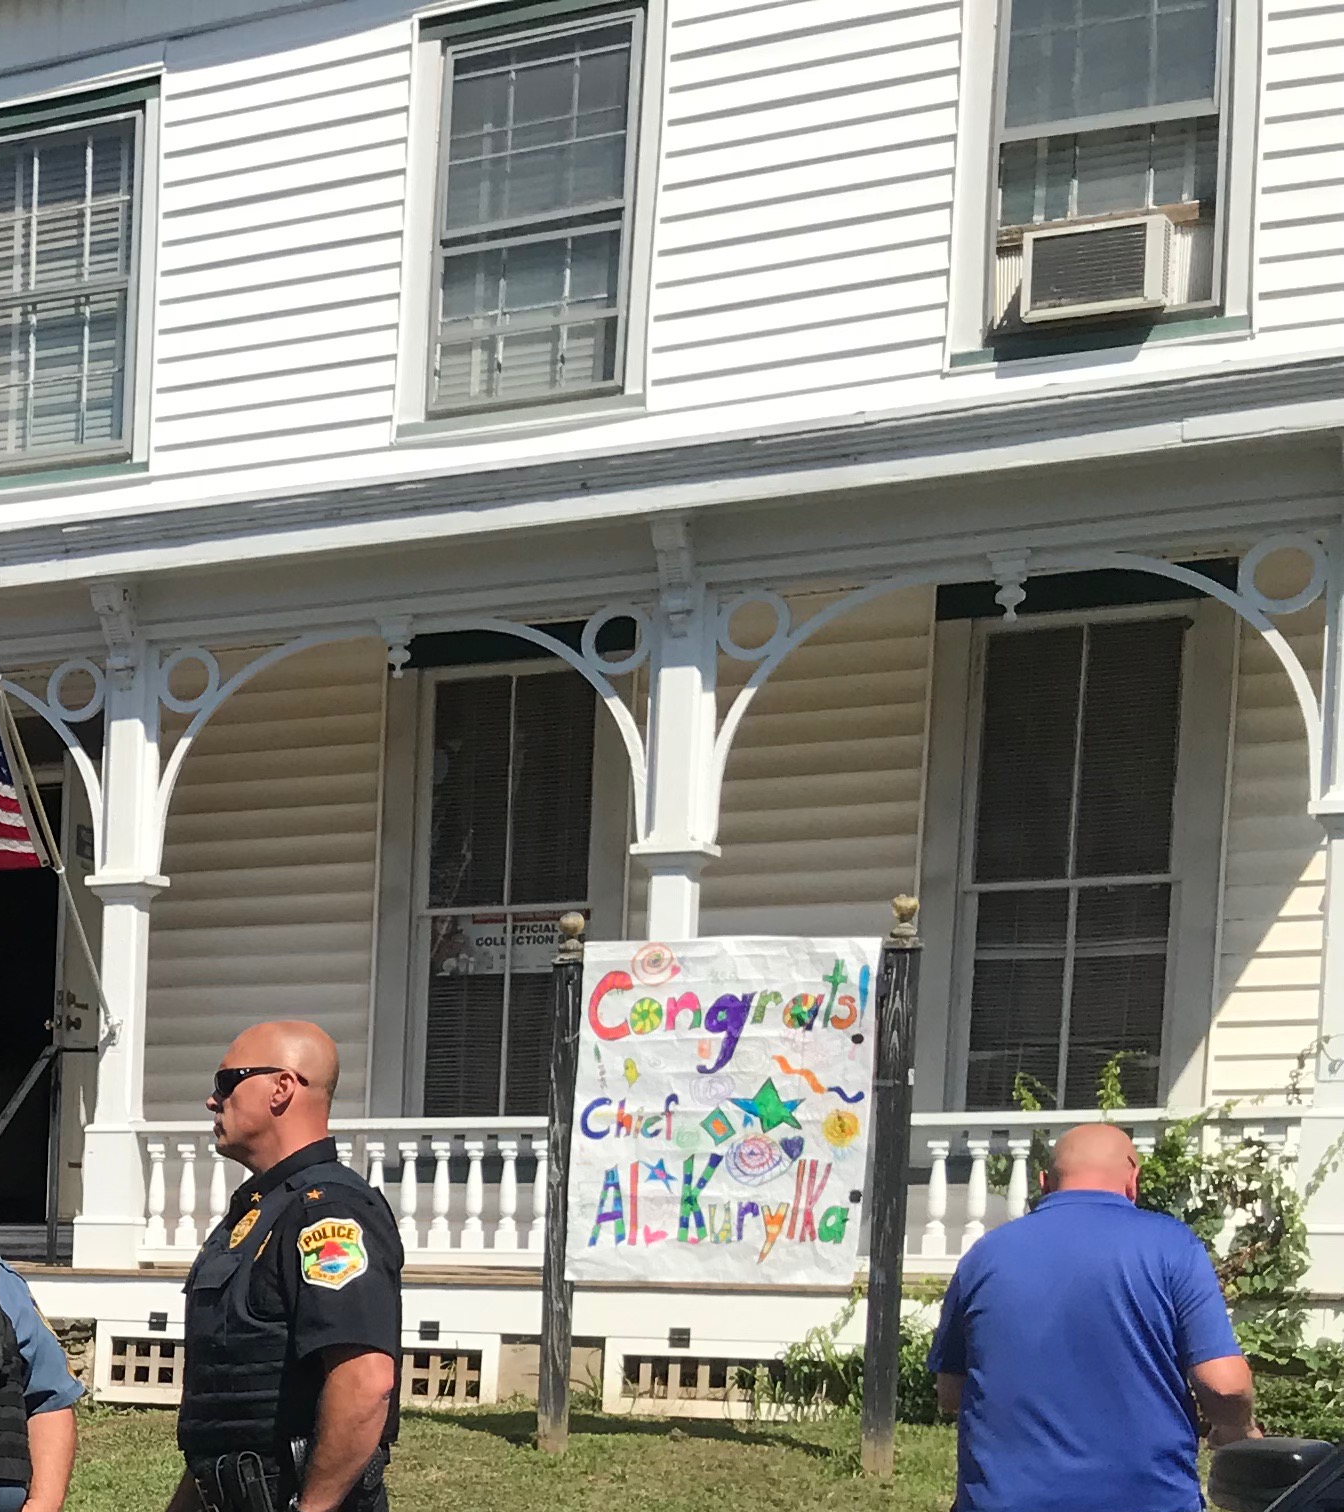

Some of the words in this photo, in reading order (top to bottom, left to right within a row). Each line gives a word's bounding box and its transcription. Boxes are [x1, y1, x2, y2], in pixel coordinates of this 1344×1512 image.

[588, 959, 870, 1074] Congrats!
[580, 1093, 679, 1141] Chief
[303, 1225, 356, 1248] POLICE
[588, 1160, 639, 1248] Al
